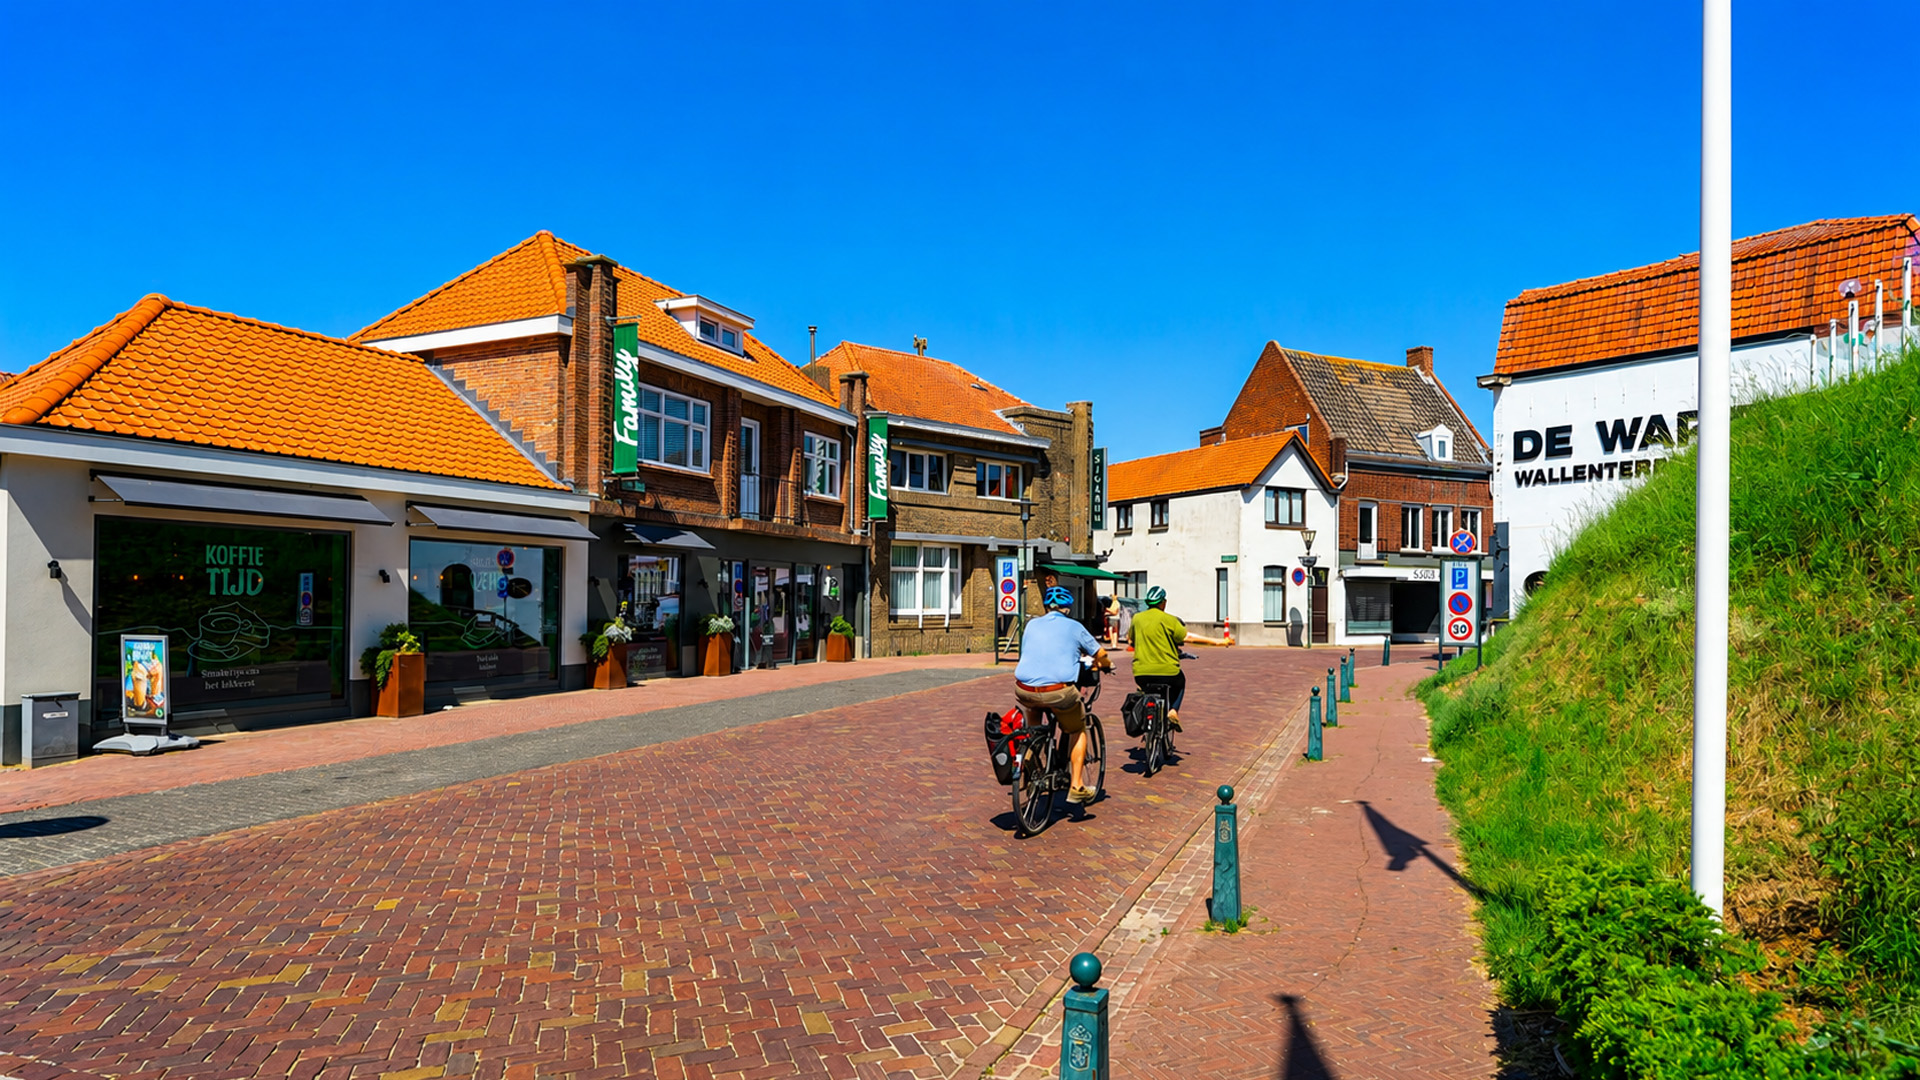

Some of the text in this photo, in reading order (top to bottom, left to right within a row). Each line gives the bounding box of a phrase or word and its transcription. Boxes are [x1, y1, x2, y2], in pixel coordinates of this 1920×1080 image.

[614, 348, 639, 447] Family
[1513, 424, 1573, 462] DE
[869, 433, 888, 501] Family
[205, 545, 264, 567] KOFFIE
[205, 567, 264, 596] TIJD
[1452, 623, 1468, 635] 30
